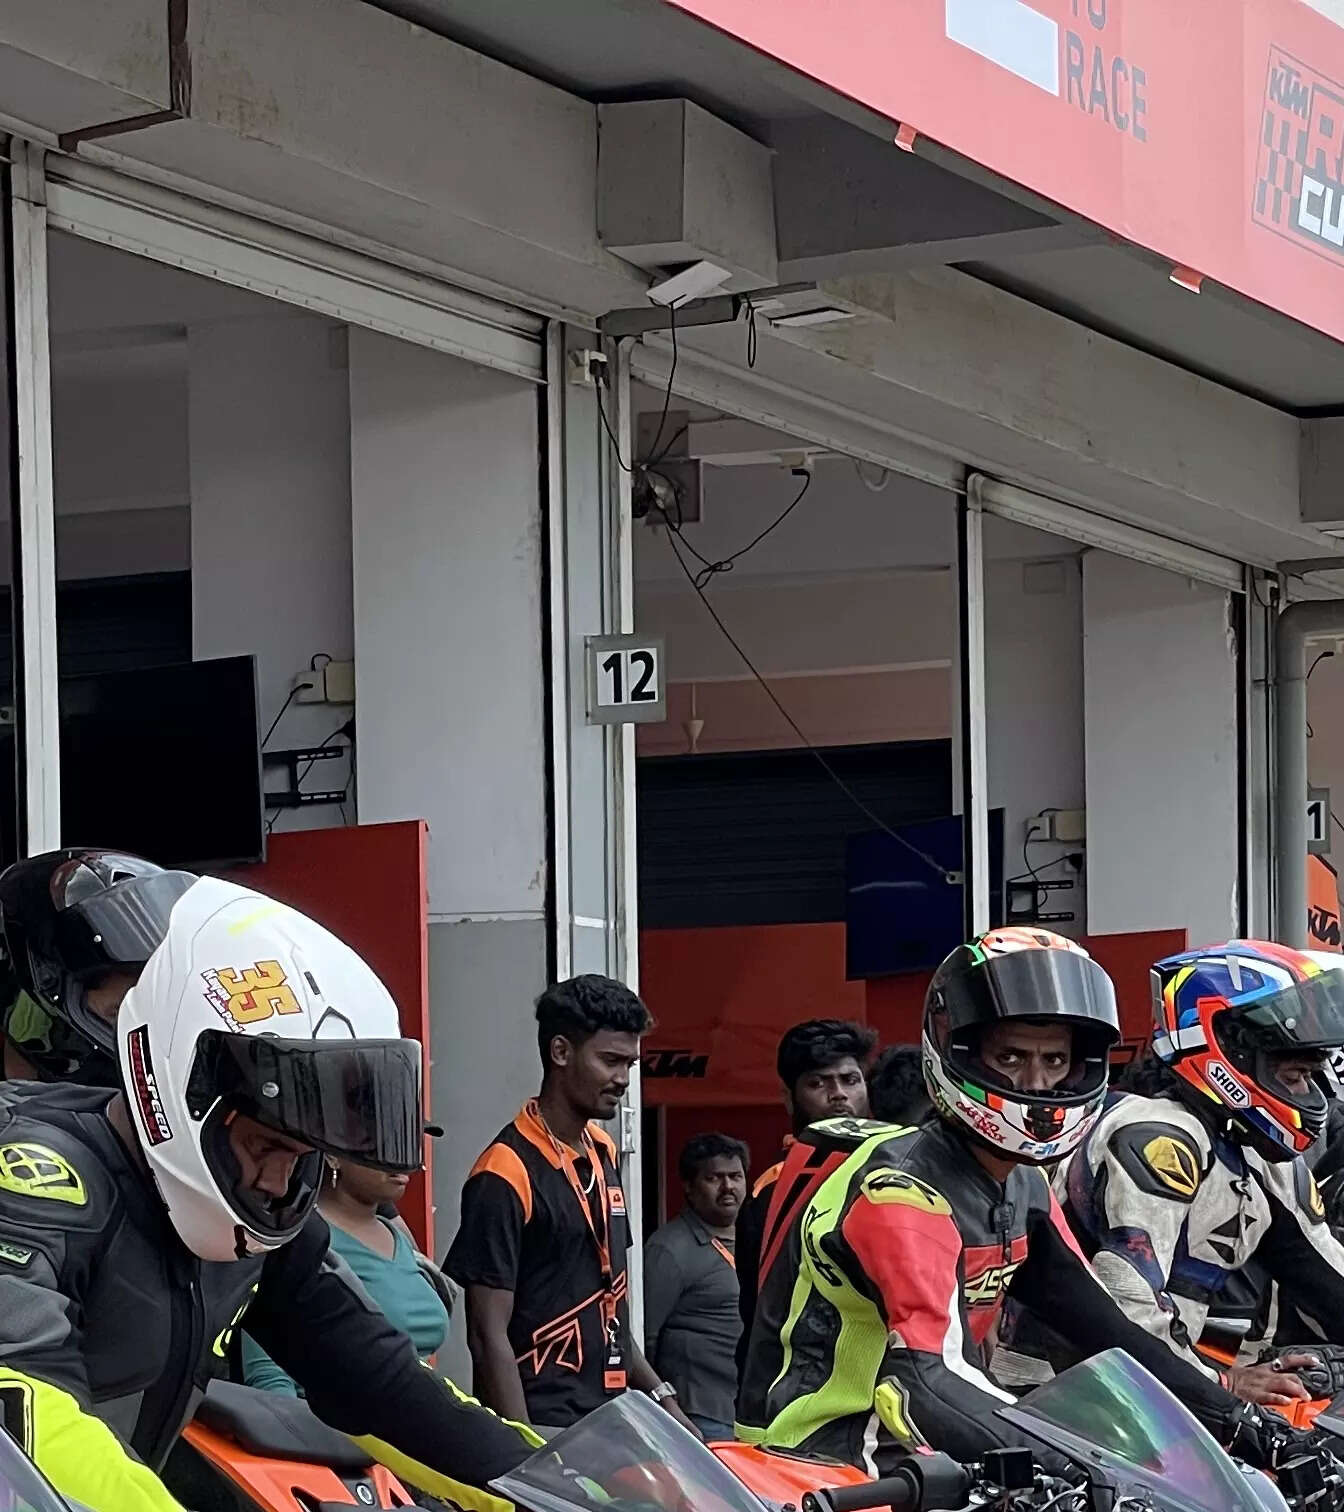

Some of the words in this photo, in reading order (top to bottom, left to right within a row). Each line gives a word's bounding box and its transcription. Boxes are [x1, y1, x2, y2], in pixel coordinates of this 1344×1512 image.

[1065, 30, 1147, 142] RACE
[601, 650, 656, 704] 12
[1306, 801, 1321, 840] 1
[217, 959, 303, 1025] 35
[146, 1073, 172, 1140] SPEED
[1210, 1065, 1247, 1104] SHOEI
